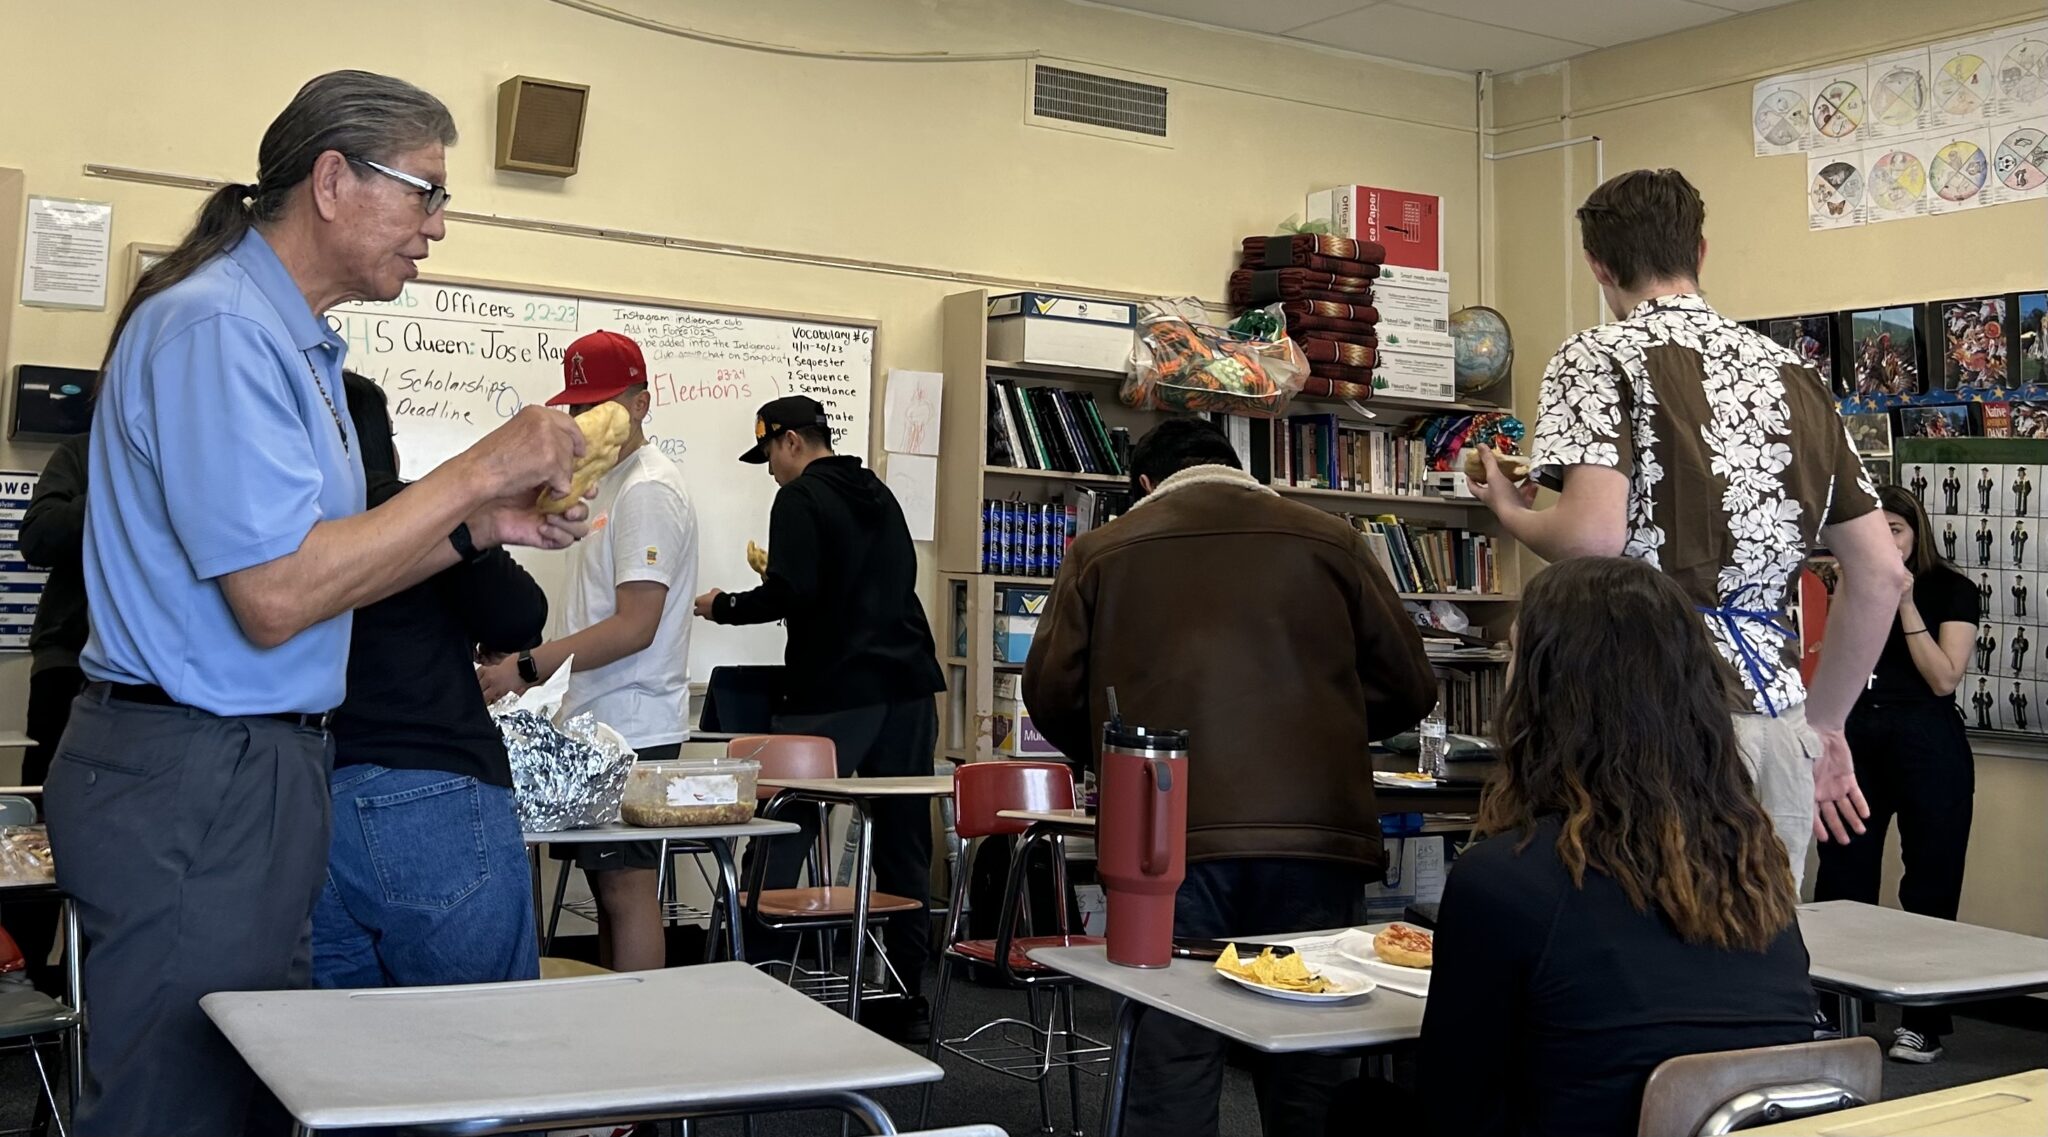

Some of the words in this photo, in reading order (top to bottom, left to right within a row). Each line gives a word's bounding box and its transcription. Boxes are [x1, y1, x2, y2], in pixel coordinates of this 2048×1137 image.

[1367, 191, 1378, 226] Paper
[435, 289, 515, 319] Officers
[524, 302, 576, 323] 22-23
[612, 308, 669, 325] Instagram
[724, 317, 743, 326] club
[481, 328, 532, 364] Jose
[660, 339, 684, 348] added
[689, 339, 710, 348] into
[713, 339, 729, 348] the
[791, 326, 850, 345] Vocabulary
[728, 352, 740, 360] on
[397, 368, 507, 402] Scholarships
[796, 370, 850, 384] Sequence
[654, 373, 752, 407] Elections
[799, 383, 857, 397] Semblance
[395, 397, 475, 426] Deadline
